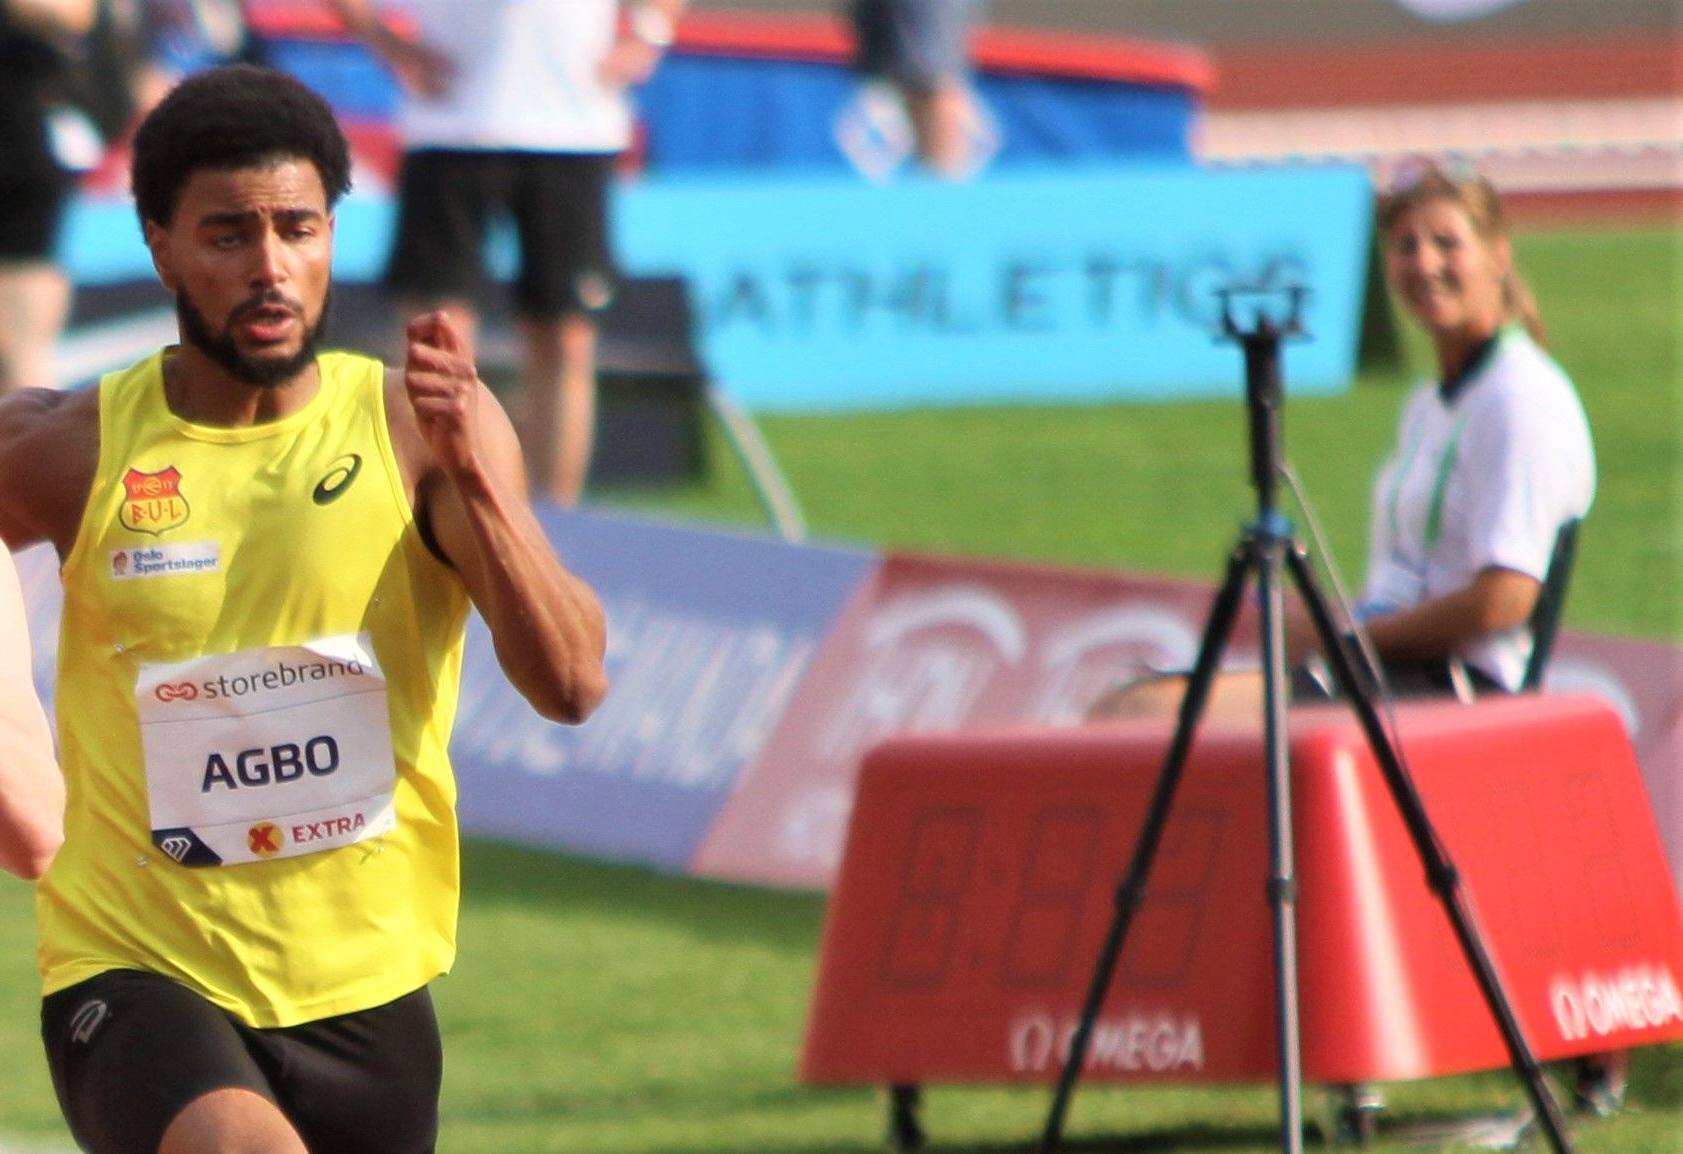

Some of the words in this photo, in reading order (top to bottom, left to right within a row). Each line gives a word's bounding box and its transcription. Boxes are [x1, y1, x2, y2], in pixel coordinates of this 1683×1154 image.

[203, 653, 364, 698] storebrand
[201, 735, 340, 793] AGBO
[292, 813, 365, 843] EXTRA
[1581, 965, 1683, 1035] OMEGA
